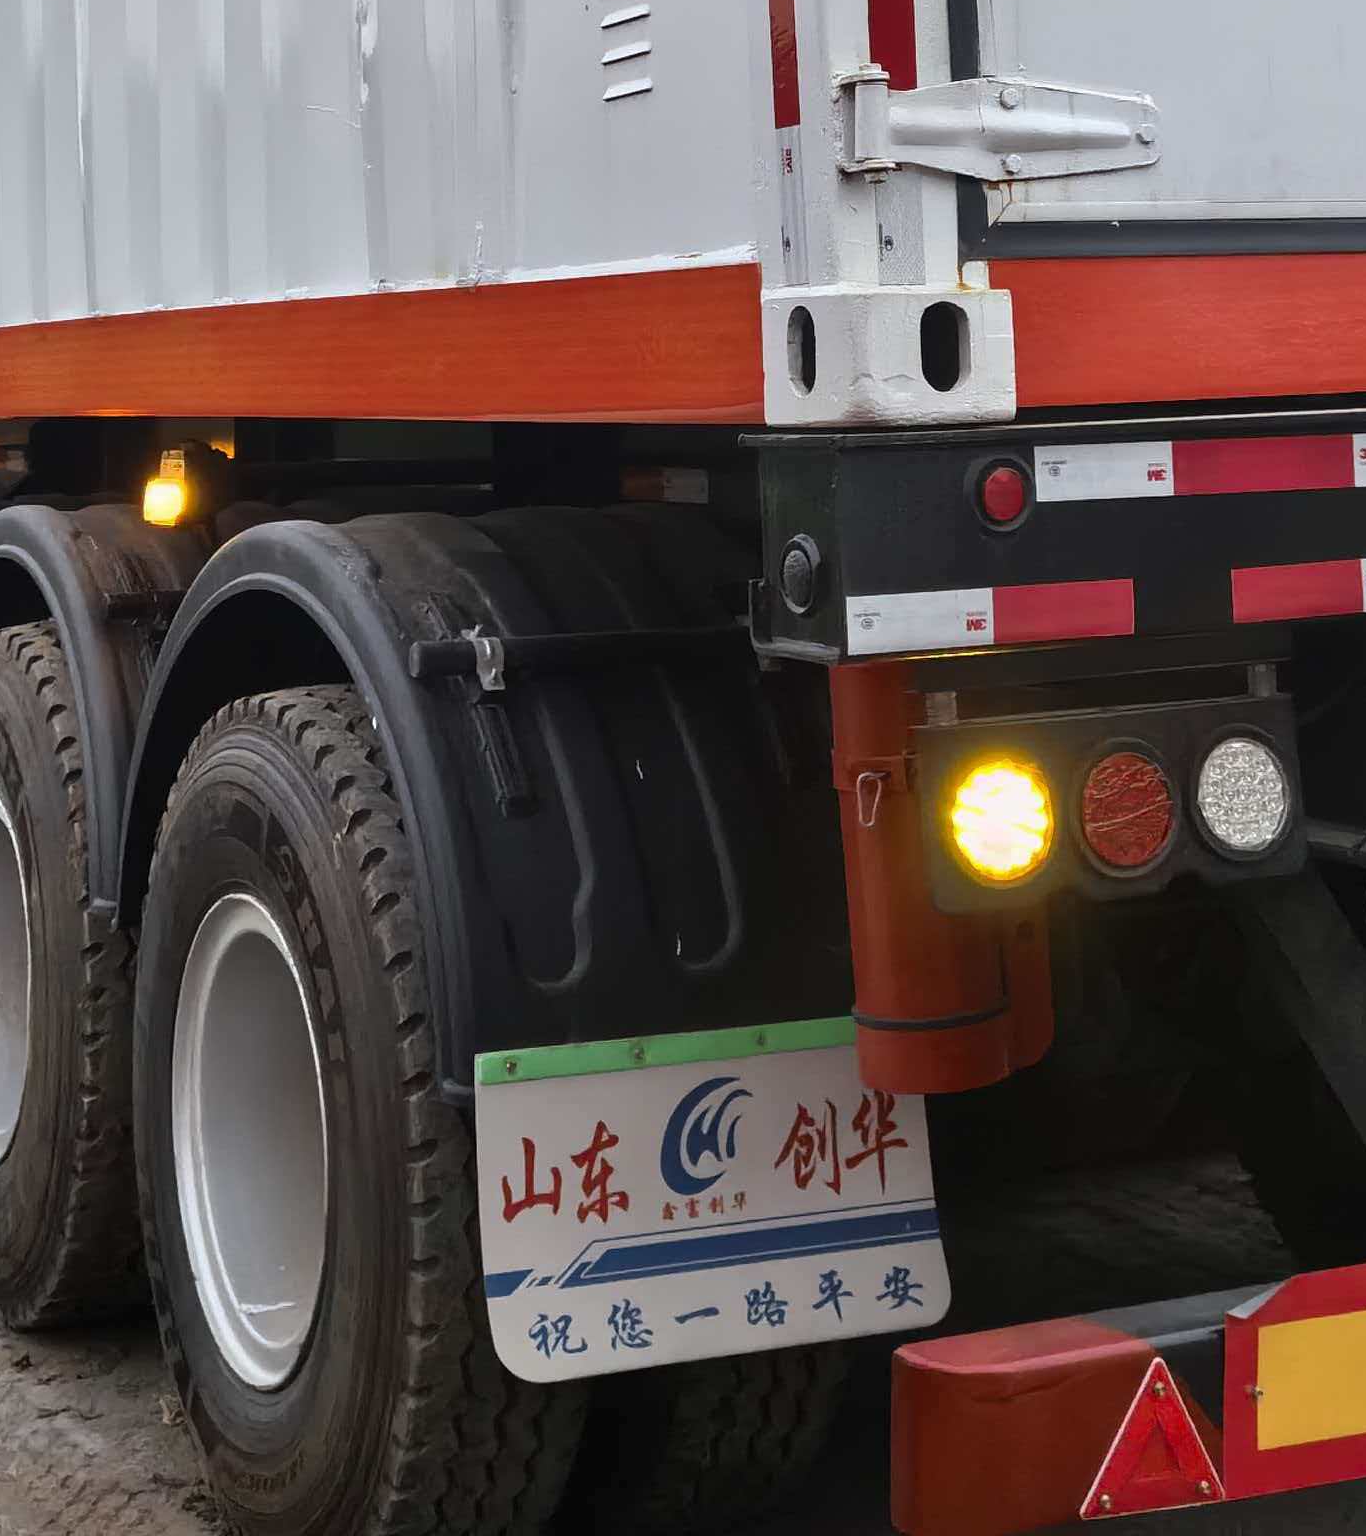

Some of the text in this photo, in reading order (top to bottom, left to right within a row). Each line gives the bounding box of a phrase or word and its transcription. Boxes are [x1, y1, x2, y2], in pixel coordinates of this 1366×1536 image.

[502, 1092, 908, 1223] 山东 创华
[528, 1266, 925, 1360] 祝您一路平安
